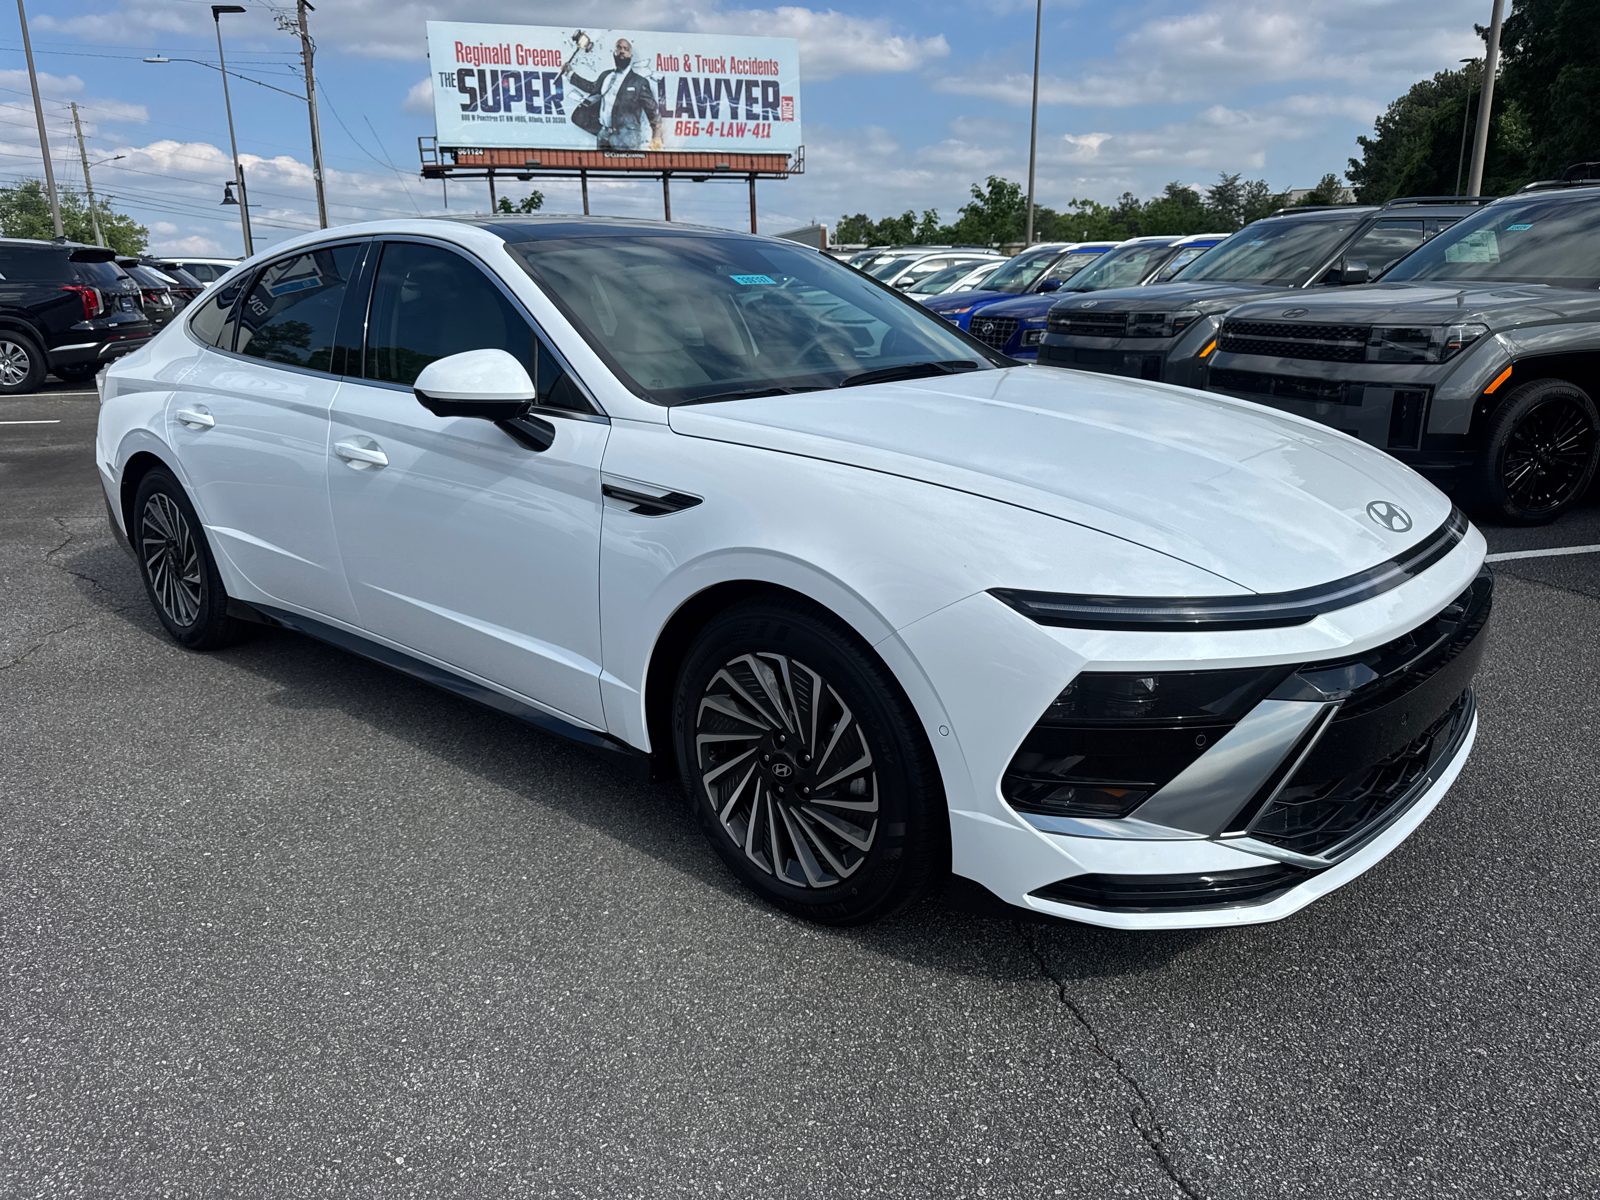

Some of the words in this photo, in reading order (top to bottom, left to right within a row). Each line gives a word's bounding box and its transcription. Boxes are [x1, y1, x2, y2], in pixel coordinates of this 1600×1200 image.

[455, 41, 511, 67] Reginald
[516, 44, 562, 67] Greene
[656, 53, 679, 72] Auto
[683, 54, 692, 72] &
[695, 55, 726, 74] Truck
[730, 56, 779, 76] Accidents
[438, 72, 457, 87] THE
[457, 68, 566, 115] SUPER
[657, 76, 781, 121] LAWYER
[674, 121, 772, 139] 866-4-LAW-411
